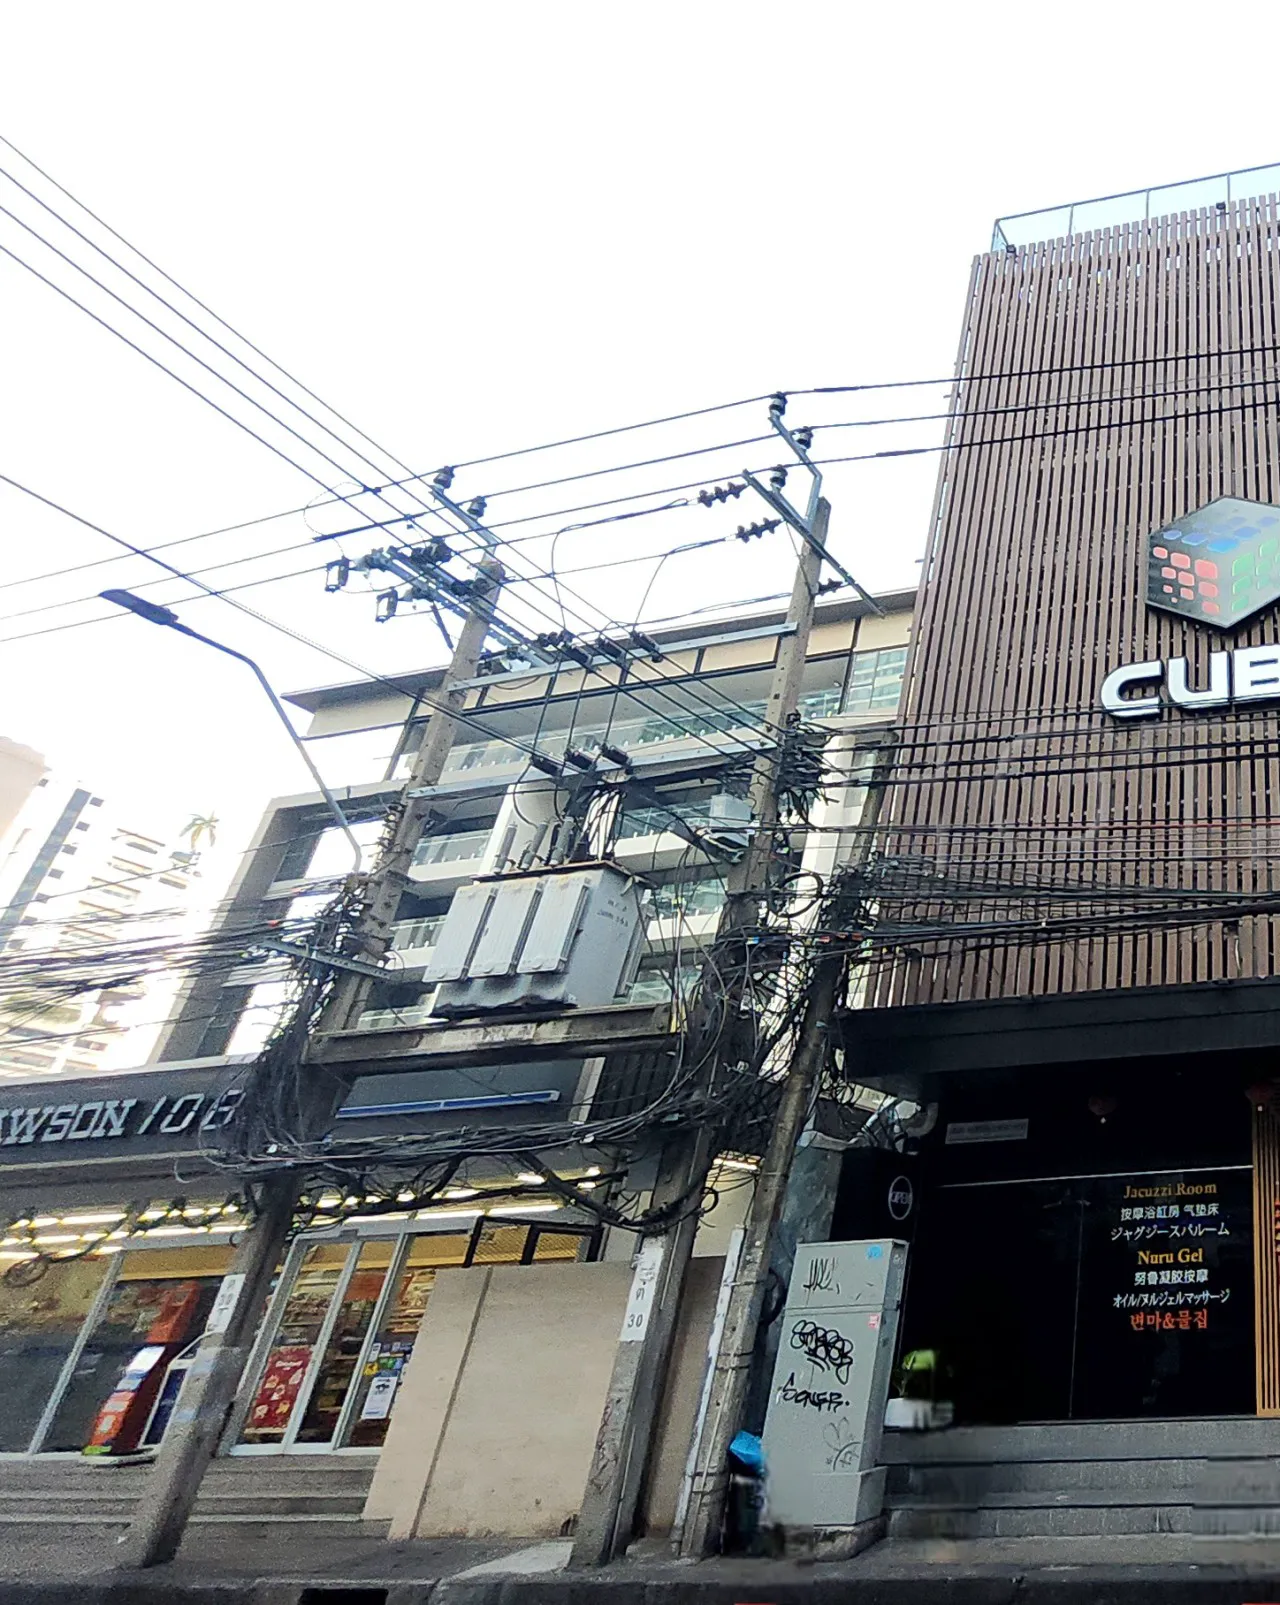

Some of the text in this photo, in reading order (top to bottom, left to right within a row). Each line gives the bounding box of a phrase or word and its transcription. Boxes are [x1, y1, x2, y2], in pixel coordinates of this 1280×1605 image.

[1123, 1182, 1218, 1199] Jacuzzi Room
[1137, 1247, 1204, 1265] Nuru Gel
[627, 1313, 644, 1329] 30
